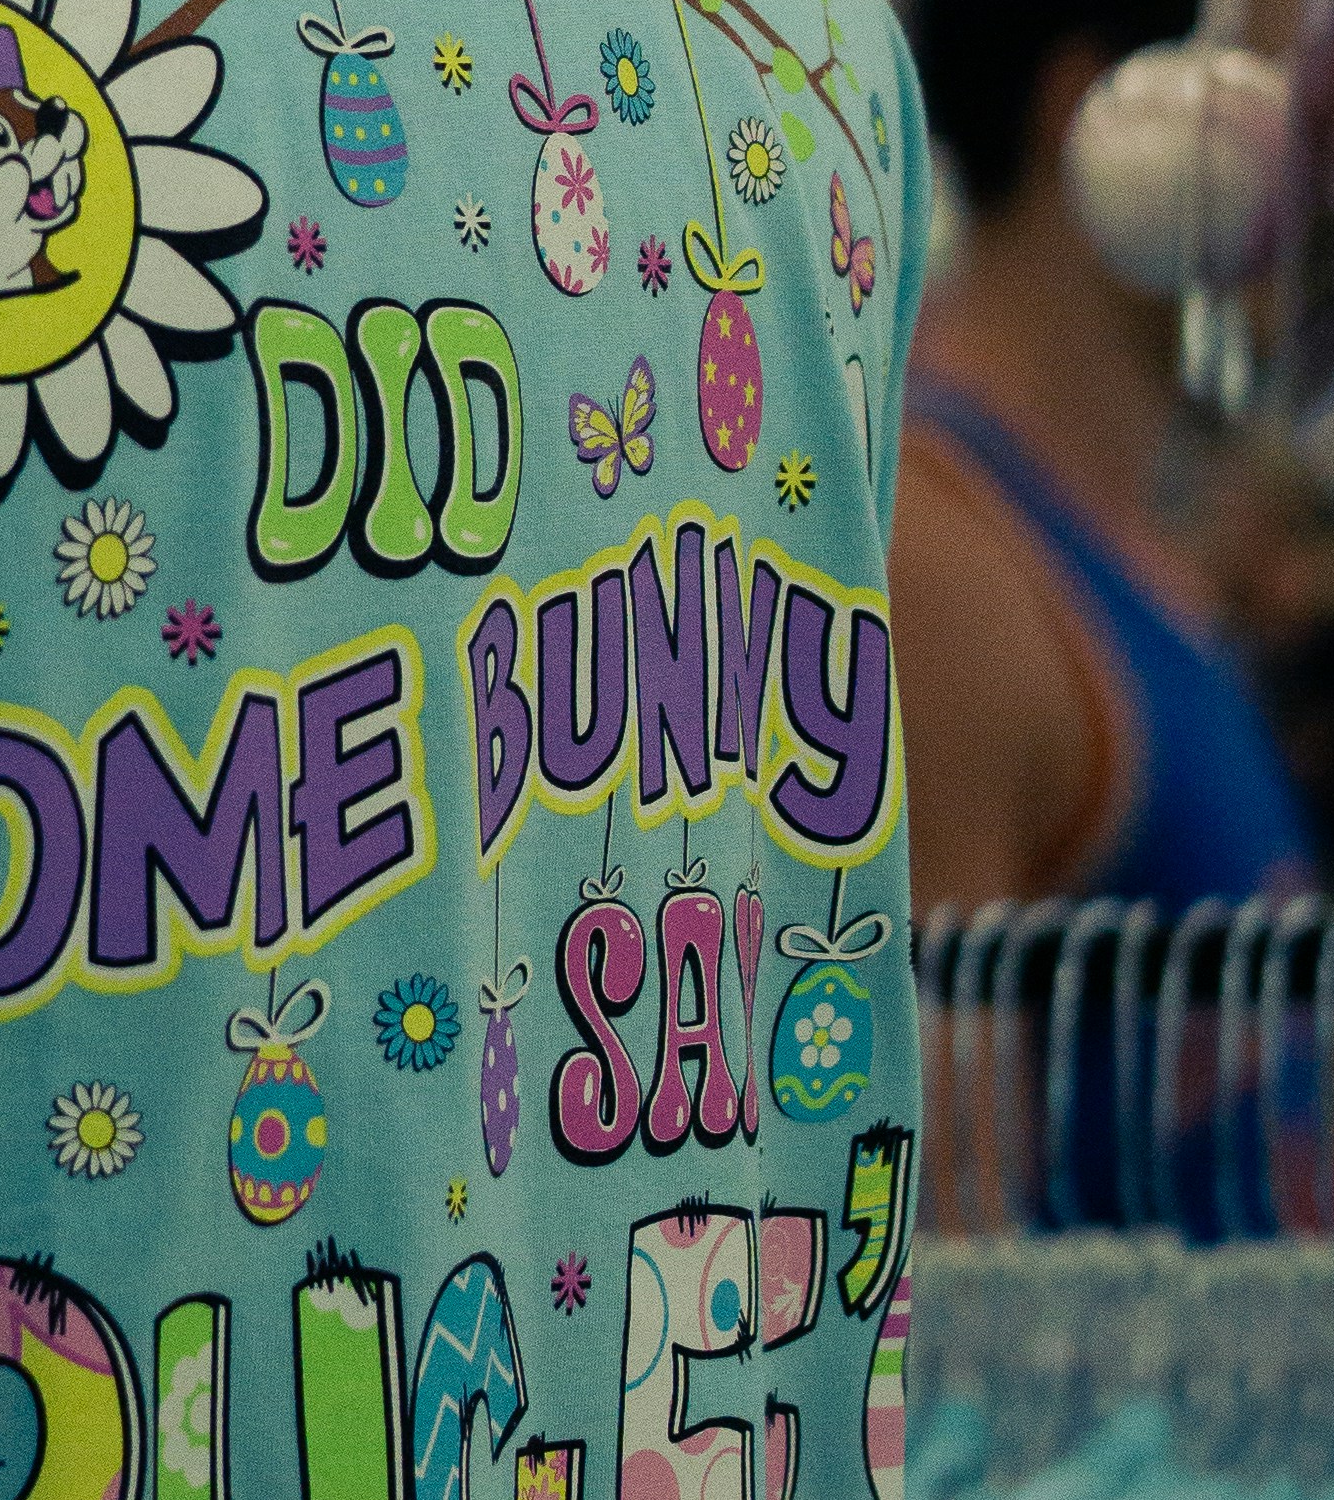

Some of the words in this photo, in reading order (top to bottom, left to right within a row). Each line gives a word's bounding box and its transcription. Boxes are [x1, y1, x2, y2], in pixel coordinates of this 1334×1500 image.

[247, 298, 523, 579] DID
[467, 519, 895, 860] BUNNY
[549, 887, 765, 1168] SAY
